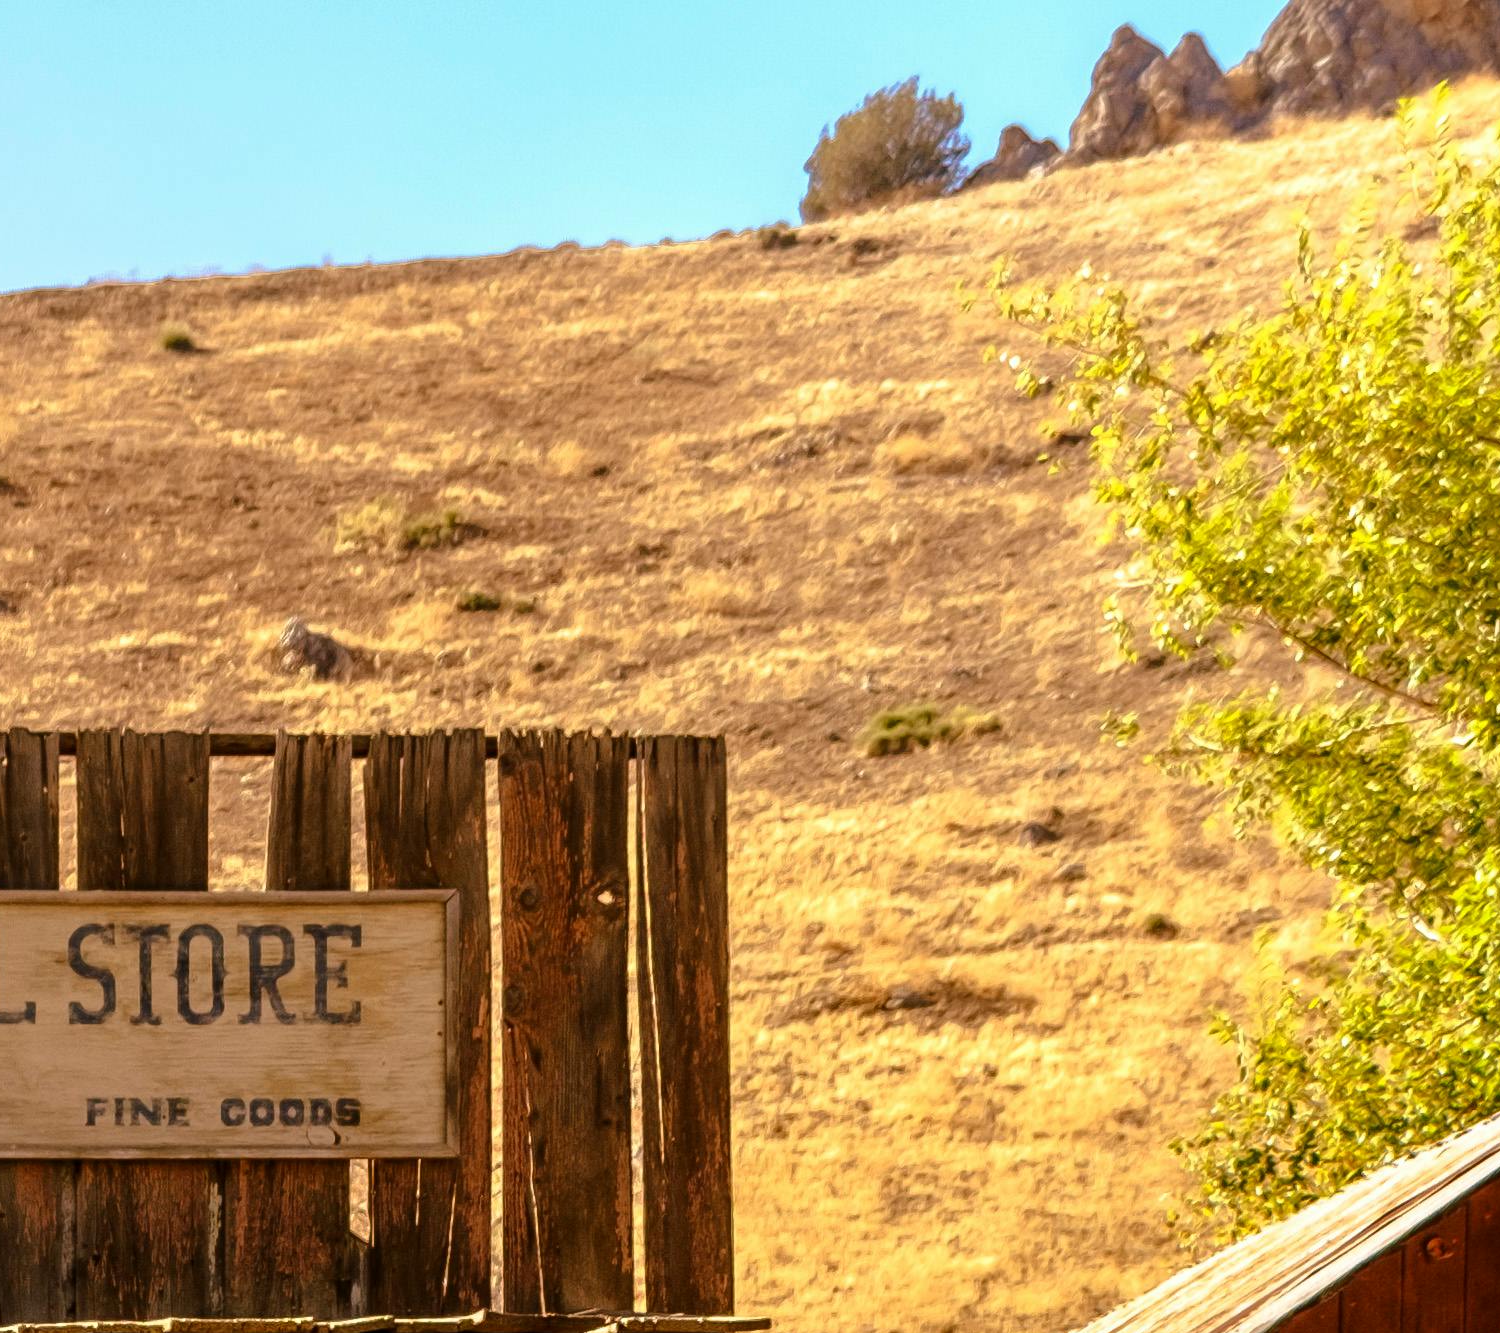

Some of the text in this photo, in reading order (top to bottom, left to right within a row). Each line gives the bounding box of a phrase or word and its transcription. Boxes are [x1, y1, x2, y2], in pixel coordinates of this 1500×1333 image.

[67, 923, 362, 1026] STORE
[85, 1096, 361, 1127] FINE GOODS
